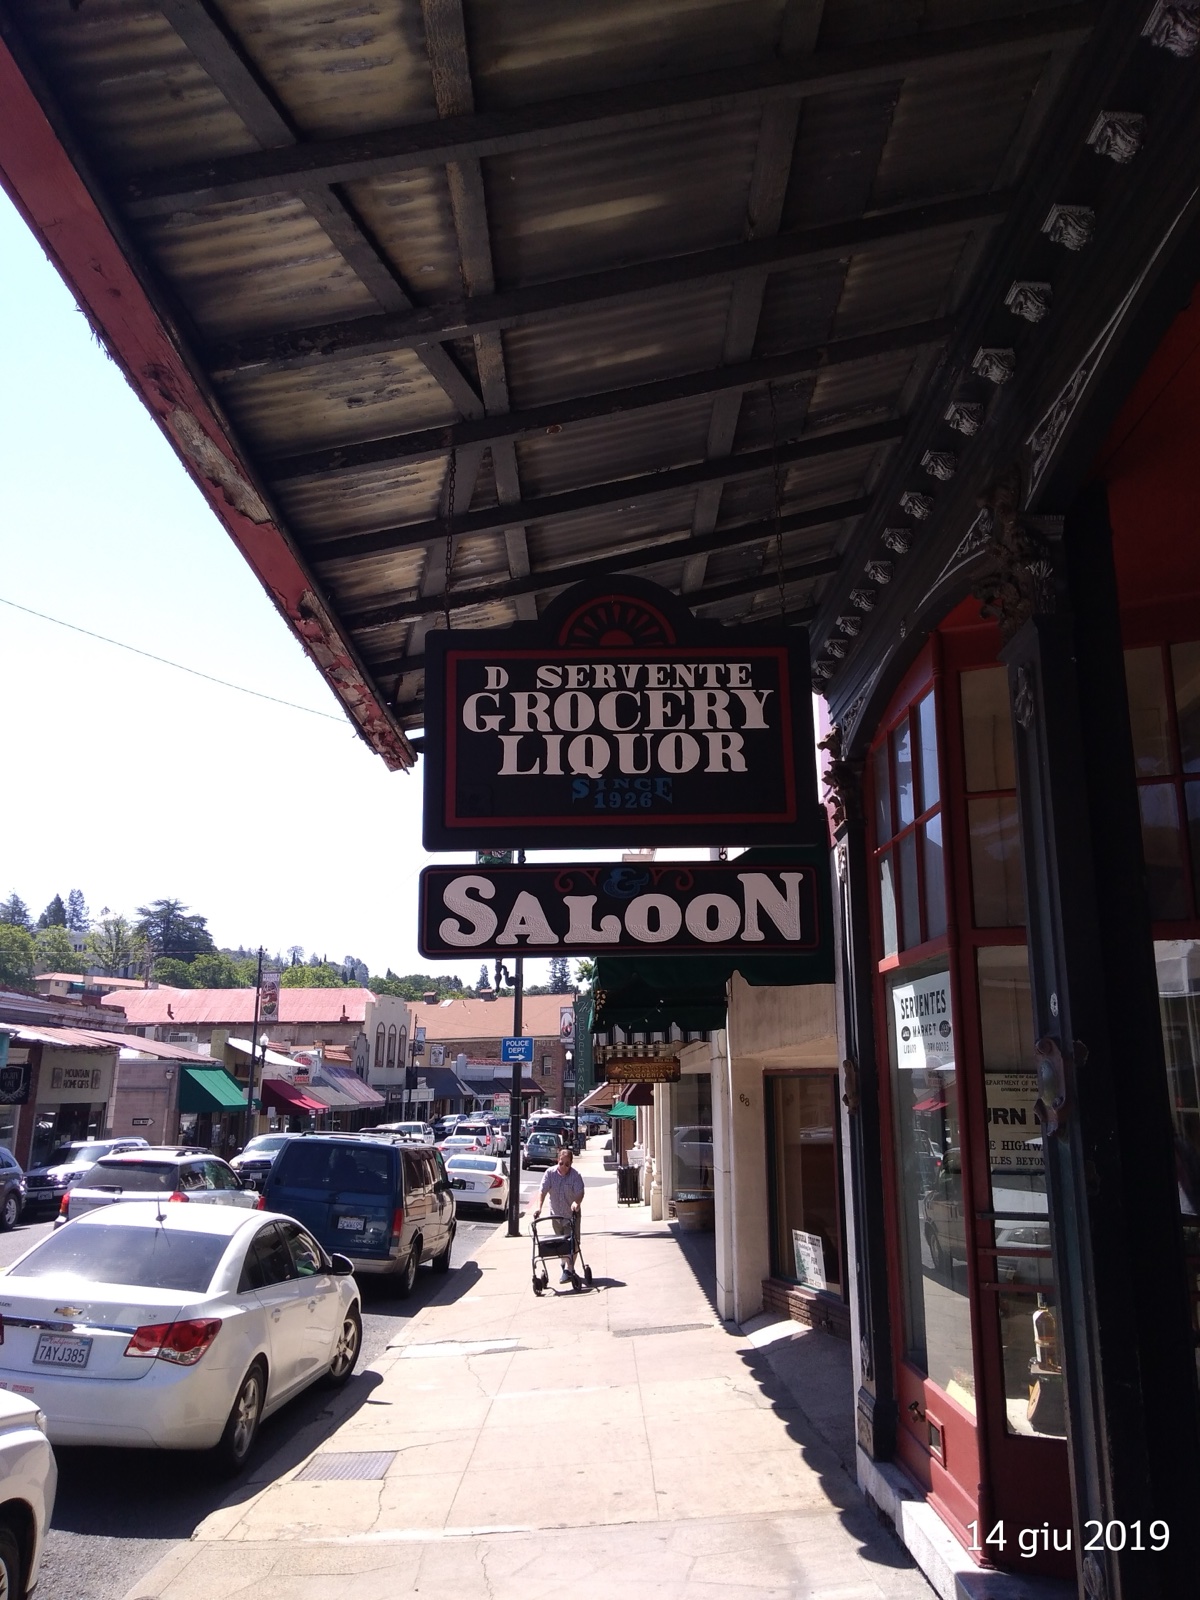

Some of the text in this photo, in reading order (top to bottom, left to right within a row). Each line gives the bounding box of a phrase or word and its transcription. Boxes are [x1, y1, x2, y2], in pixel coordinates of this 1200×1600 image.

[484, 664, 753, 690] D SERVENTE
[462, 689, 774, 733] GROCERY
[497, 732, 749, 779] LIQUOR
[572, 777, 673, 804] SINCE
[594, 793, 653, 809] 1926
[438, 872, 804, 947] SALOON
[900, 989, 947, 1020] SERVENTES
[912, 1022, 937, 1038] MARKET
[578, 1018, 586, 1091] SPORTSMAN
[63, 1080, 90, 1089] HOME GIFTS
[64, 1069, 91, 1078] MOUNTAIN
[740, 1093, 750, 1107] 68
[1001, 1140, 1043, 1151] HIGHW
[40, 1345, 86, 1363] 7AYJ385
